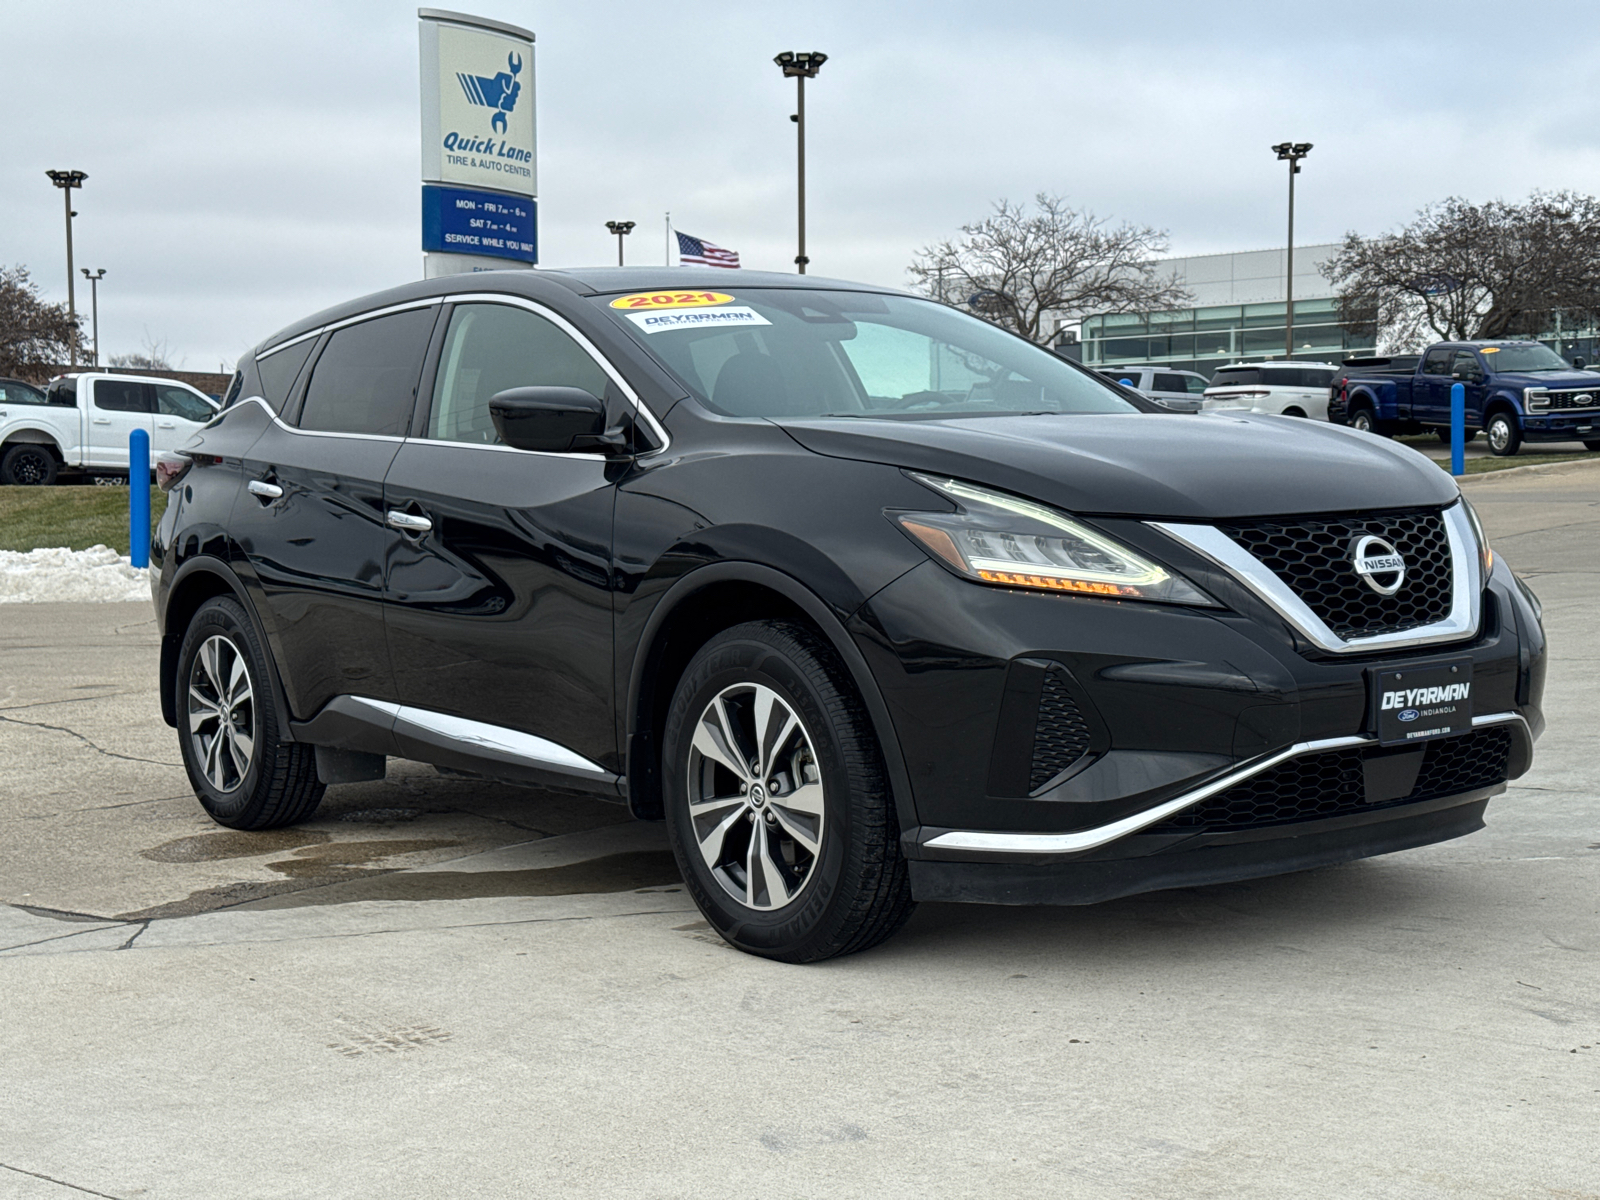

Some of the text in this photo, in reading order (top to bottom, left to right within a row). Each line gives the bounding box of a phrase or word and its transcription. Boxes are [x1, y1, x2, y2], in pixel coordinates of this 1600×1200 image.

[443, 131, 532, 163] Quick Lane
[446, 154, 531, 178] TIRE & AUTO CENTER
[456, 200, 476, 210] MON
[484, 202, 496, 213] FRI
[469, 218, 485, 228] SAT
[444, 234, 534, 252] SERVICE WHILE YOU WAIT
[627, 292, 718, 308] 2021
[645, 312, 752, 325] DEYARMAN
[1364, 558, 1404, 570] NISSAN
[1381, 682, 1471, 711] DEYARMAN
[1420, 705, 1457, 717] INDIANOLA
